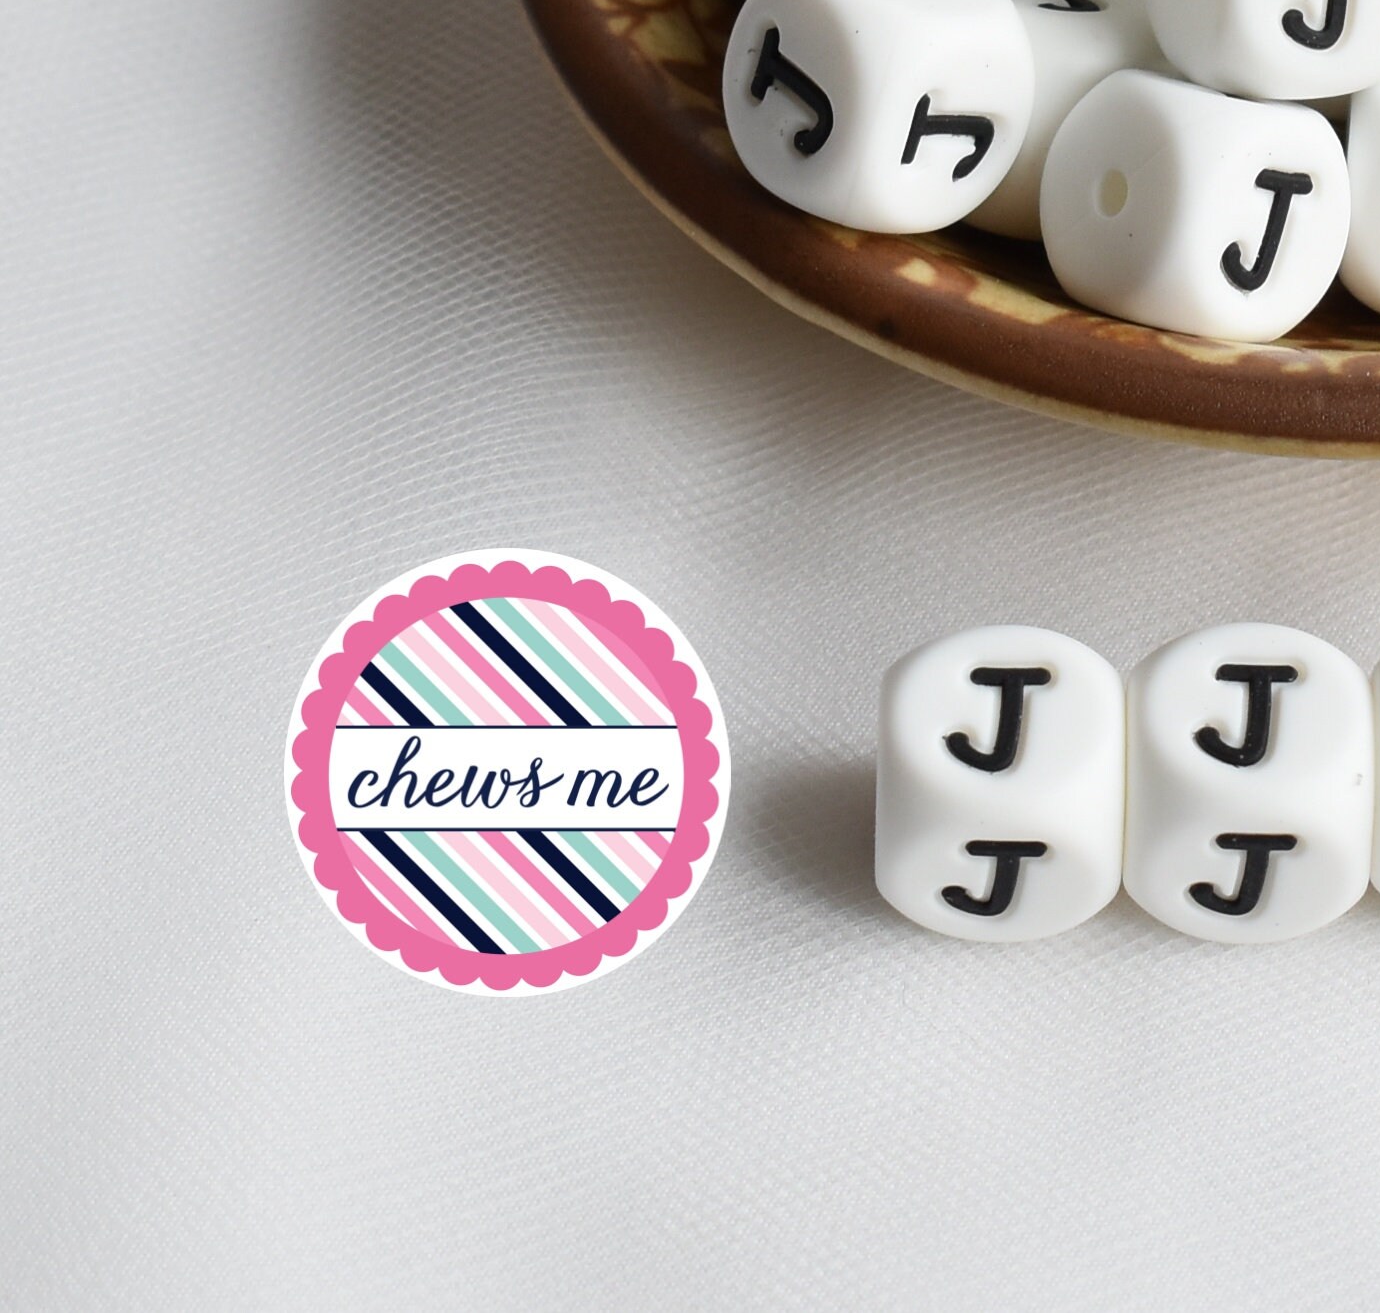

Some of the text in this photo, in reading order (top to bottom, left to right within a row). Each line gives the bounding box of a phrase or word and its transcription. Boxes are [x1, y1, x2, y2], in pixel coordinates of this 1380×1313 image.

[747, 25, 835, 160] J
[900, 94, 996, 179] J
[1220, 168, 1314, 291] J
[944, 666, 1052, 774] J
[1194, 663, 1299, 769] J
[940, 839, 1049, 918] J
[1187, 832, 1299, 917] J
